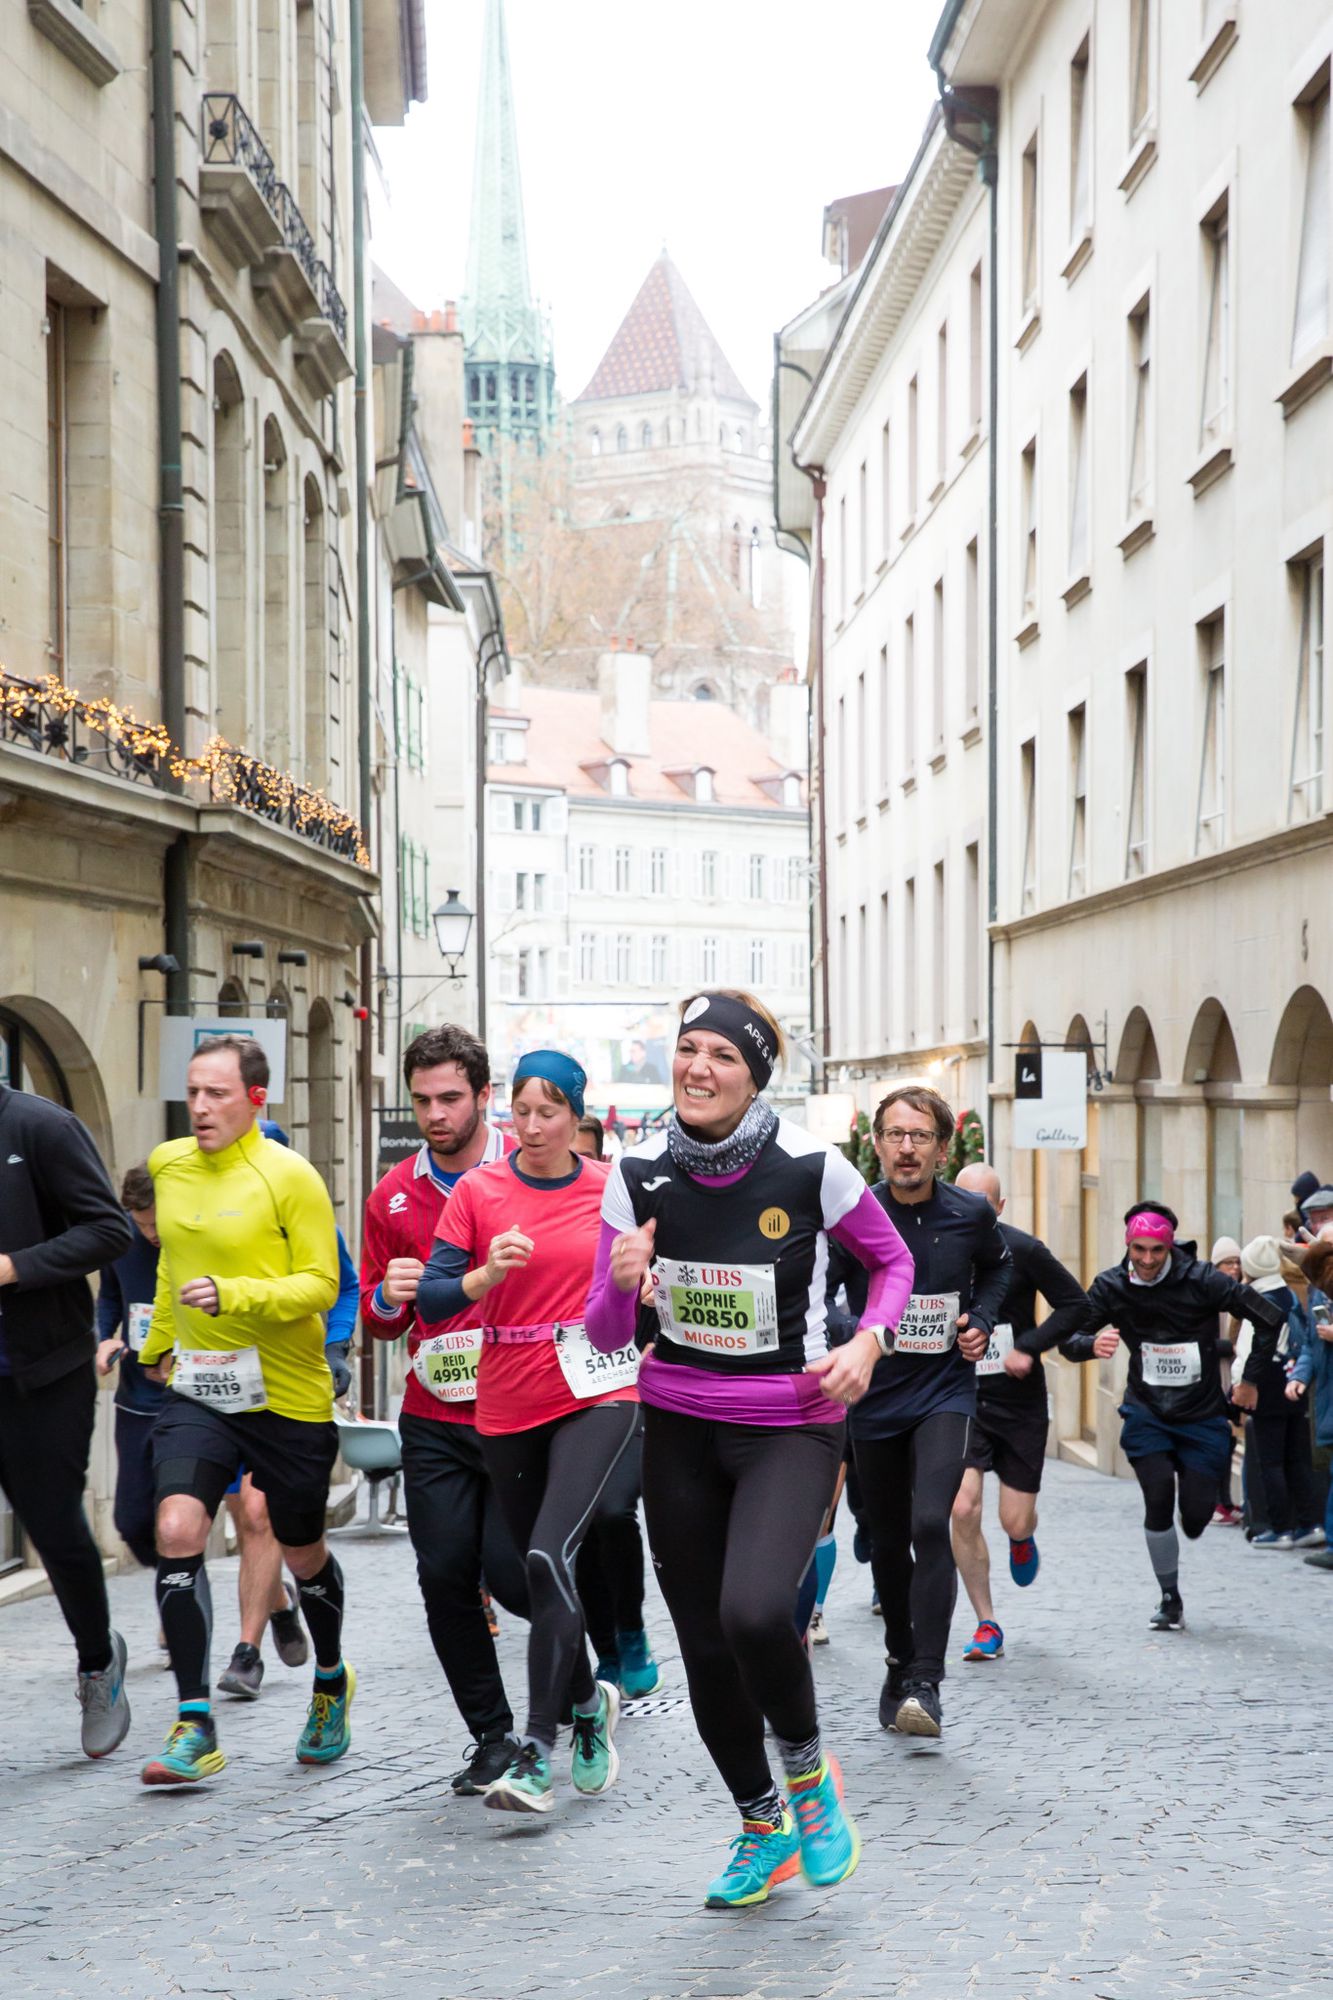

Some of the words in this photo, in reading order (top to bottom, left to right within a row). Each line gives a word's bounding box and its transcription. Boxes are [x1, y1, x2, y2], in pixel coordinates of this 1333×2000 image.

[744, 1022, 765, 1048] APE
[1036, 1128, 1080, 1146] Gallery
[701, 1267, 743, 1287] UBS
[685, 1291, 737, 1309] SOPHIE
[920, 1298, 945, 1310] UBS
[678, 1306, 749, 1330] 20850
[901, 1312, 948, 1323] EAN-MARIE
[899, 1323, 945, 1337] 53674
[446, 1335, 474, 1350] UBS
[684, 1330, 748, 1349] MIGROS
[899, 1340, 943, 1350] MIGROS
[1152, 1346, 1185, 1355] MIGROS
[192, 1353, 238, 1366] MIGROS
[442, 1354, 466, 1368] REID
[585, 1347, 637, 1375] 54120
[193, 1370, 237, 1384] NICOLAS
[1156, 1365, 1187, 1375] 19307
[192, 1382, 242, 1397] 37419
[438, 1386, 476, 1398] MIGRO
